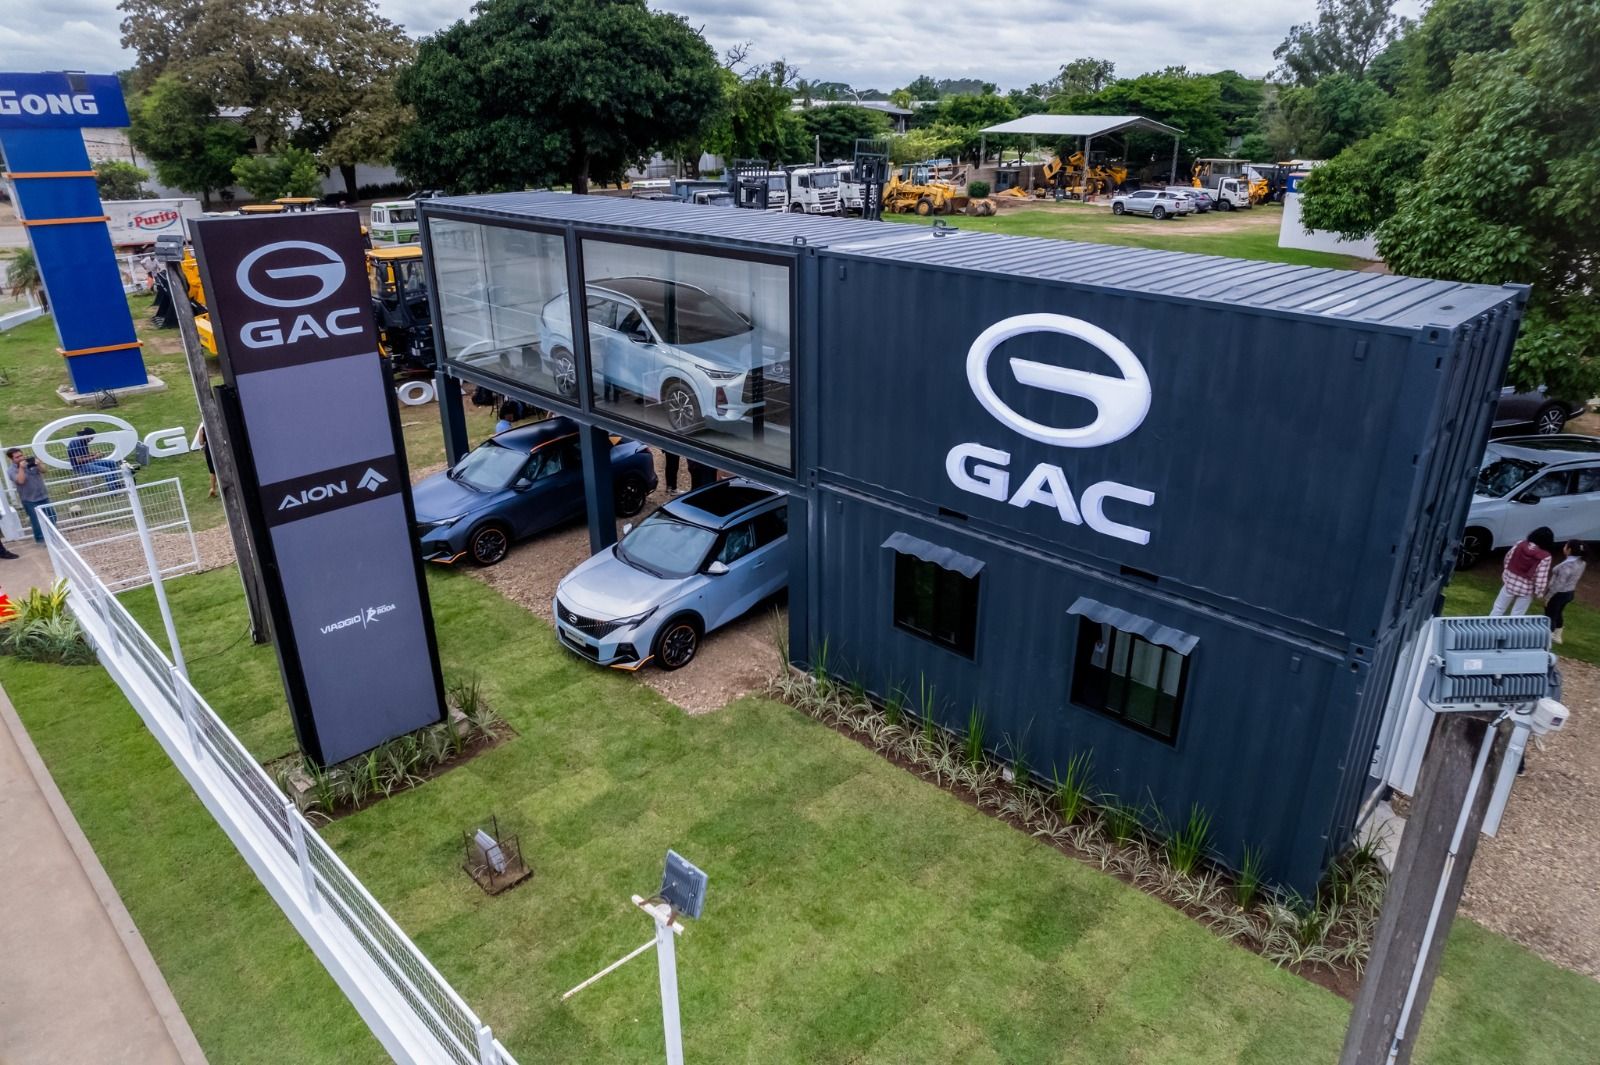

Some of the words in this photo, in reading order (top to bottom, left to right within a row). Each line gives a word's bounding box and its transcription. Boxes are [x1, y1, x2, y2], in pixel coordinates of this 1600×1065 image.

[134, 210, 179, 228] Purita
[240, 307, 363, 349] GAC
[278, 480, 348, 511] AION
[945, 442, 1155, 546] GAC
